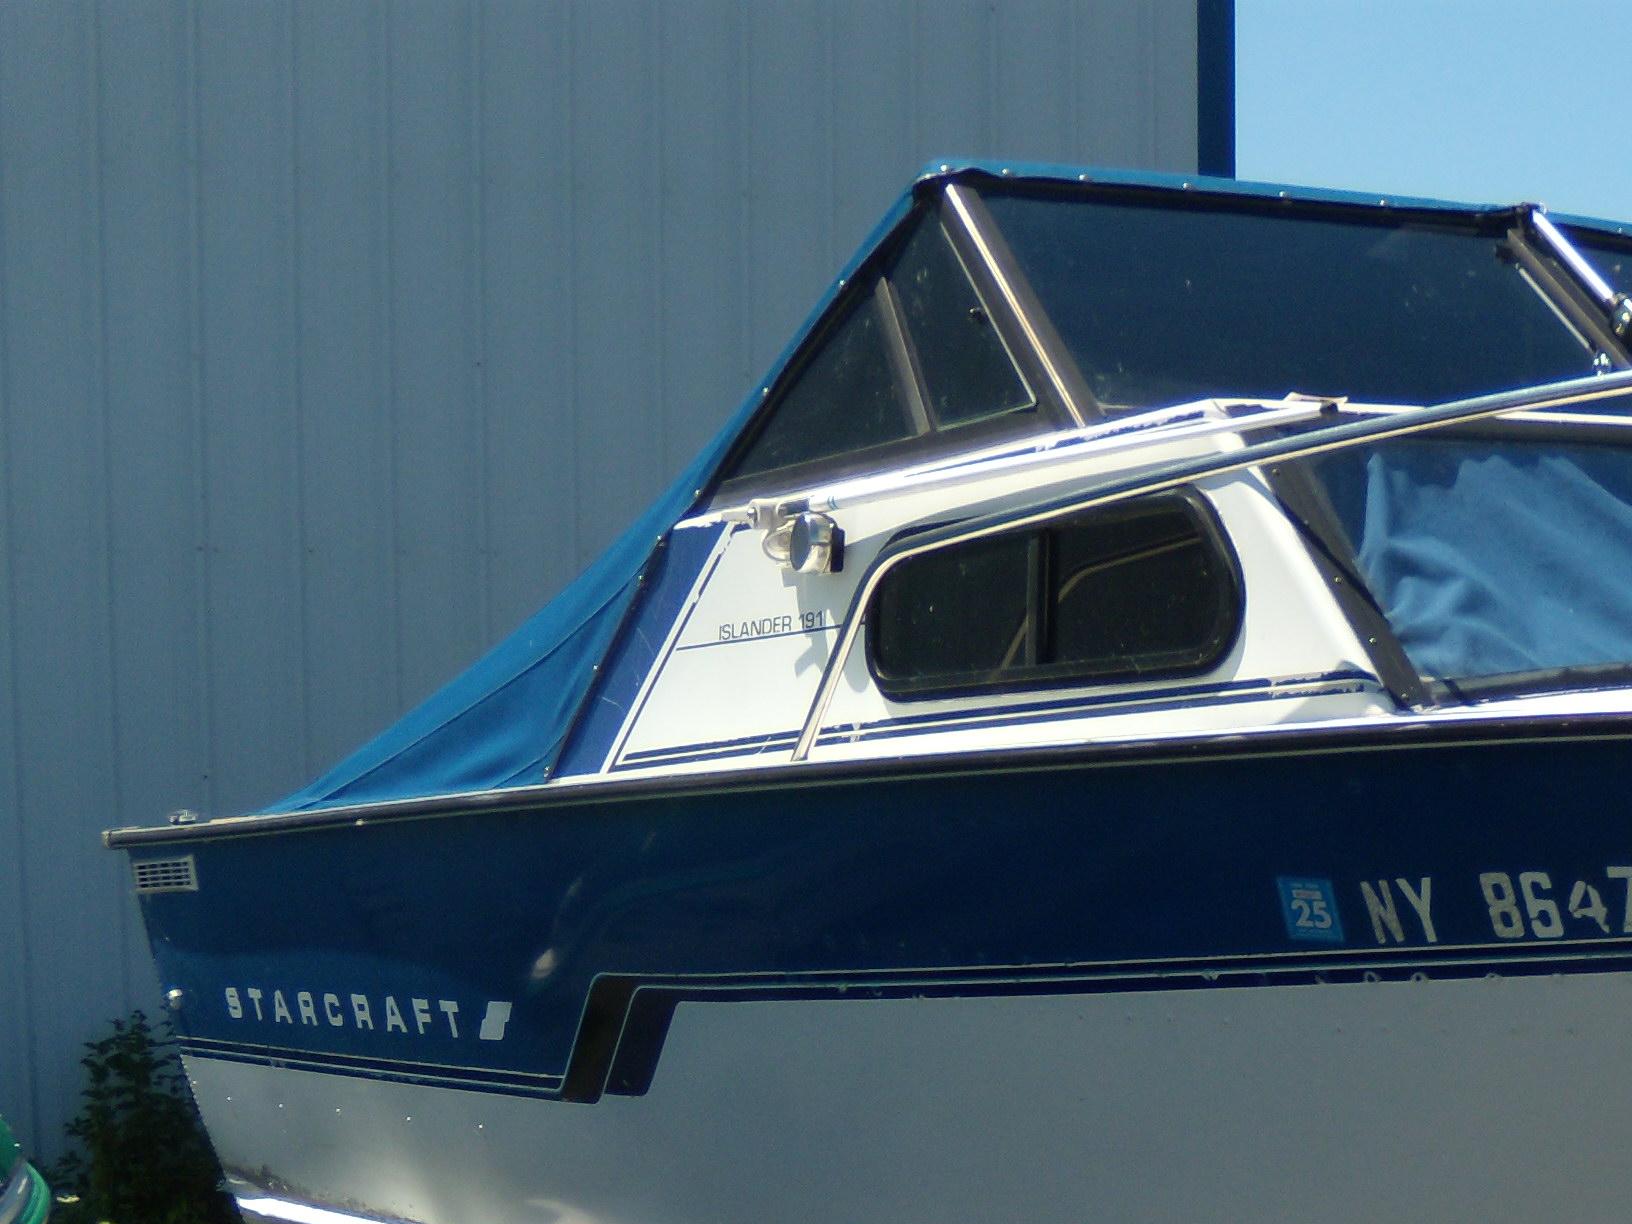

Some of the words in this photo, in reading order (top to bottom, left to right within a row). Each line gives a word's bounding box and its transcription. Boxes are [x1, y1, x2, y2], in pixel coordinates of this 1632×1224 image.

[718, 615, 792, 640] ISLANDER
[799, 610, 824, 629] 191
[1290, 899, 1333, 929] 25
[1359, 876, 1437, 944] NY
[224, 986, 459, 1039] STARCRAFT
